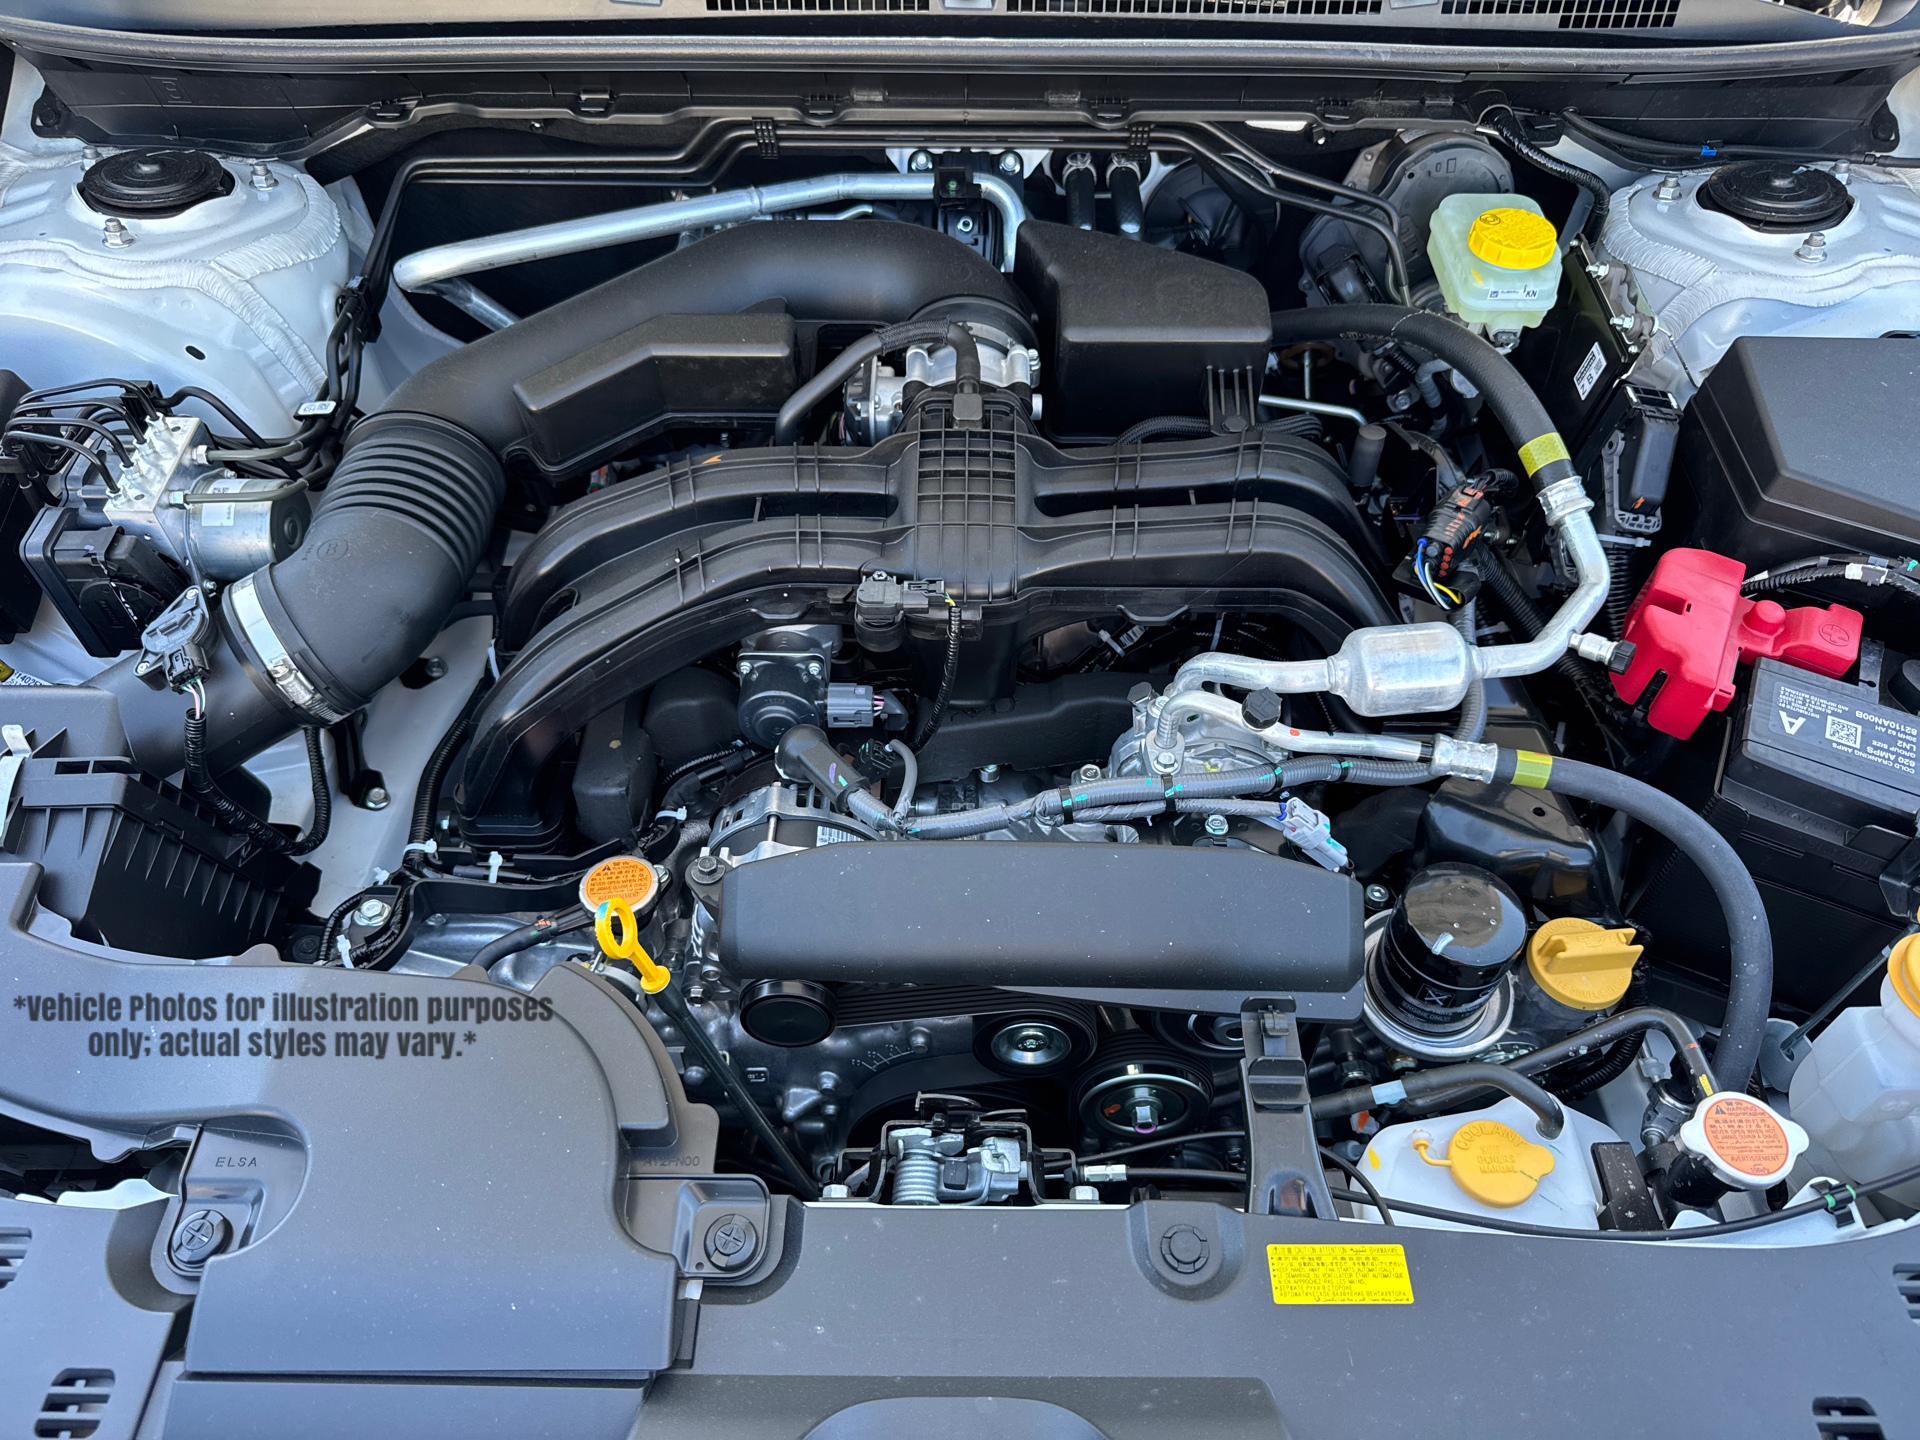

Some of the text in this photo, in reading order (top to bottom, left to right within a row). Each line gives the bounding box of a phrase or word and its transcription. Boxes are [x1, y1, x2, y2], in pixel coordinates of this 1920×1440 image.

[1872, 739, 1915, 758] GROUP SIZE
[1897, 739, 1916, 752] LN2
[1832, 742, 1914, 774] COLD CRANKING AMPS
[1867, 746, 1915, 767] 620 AMPS
[1538, 920, 1577, 941] ENGINE
[1553, 978, 1569, 991] SEE
[1455, 1123, 1526, 1150] COOLANT
[1480, 1145, 1500, 1154] SEE
[215, 1156, 257, 1167] ELSA
[1479, 1164, 1519, 1174] MANUAL
